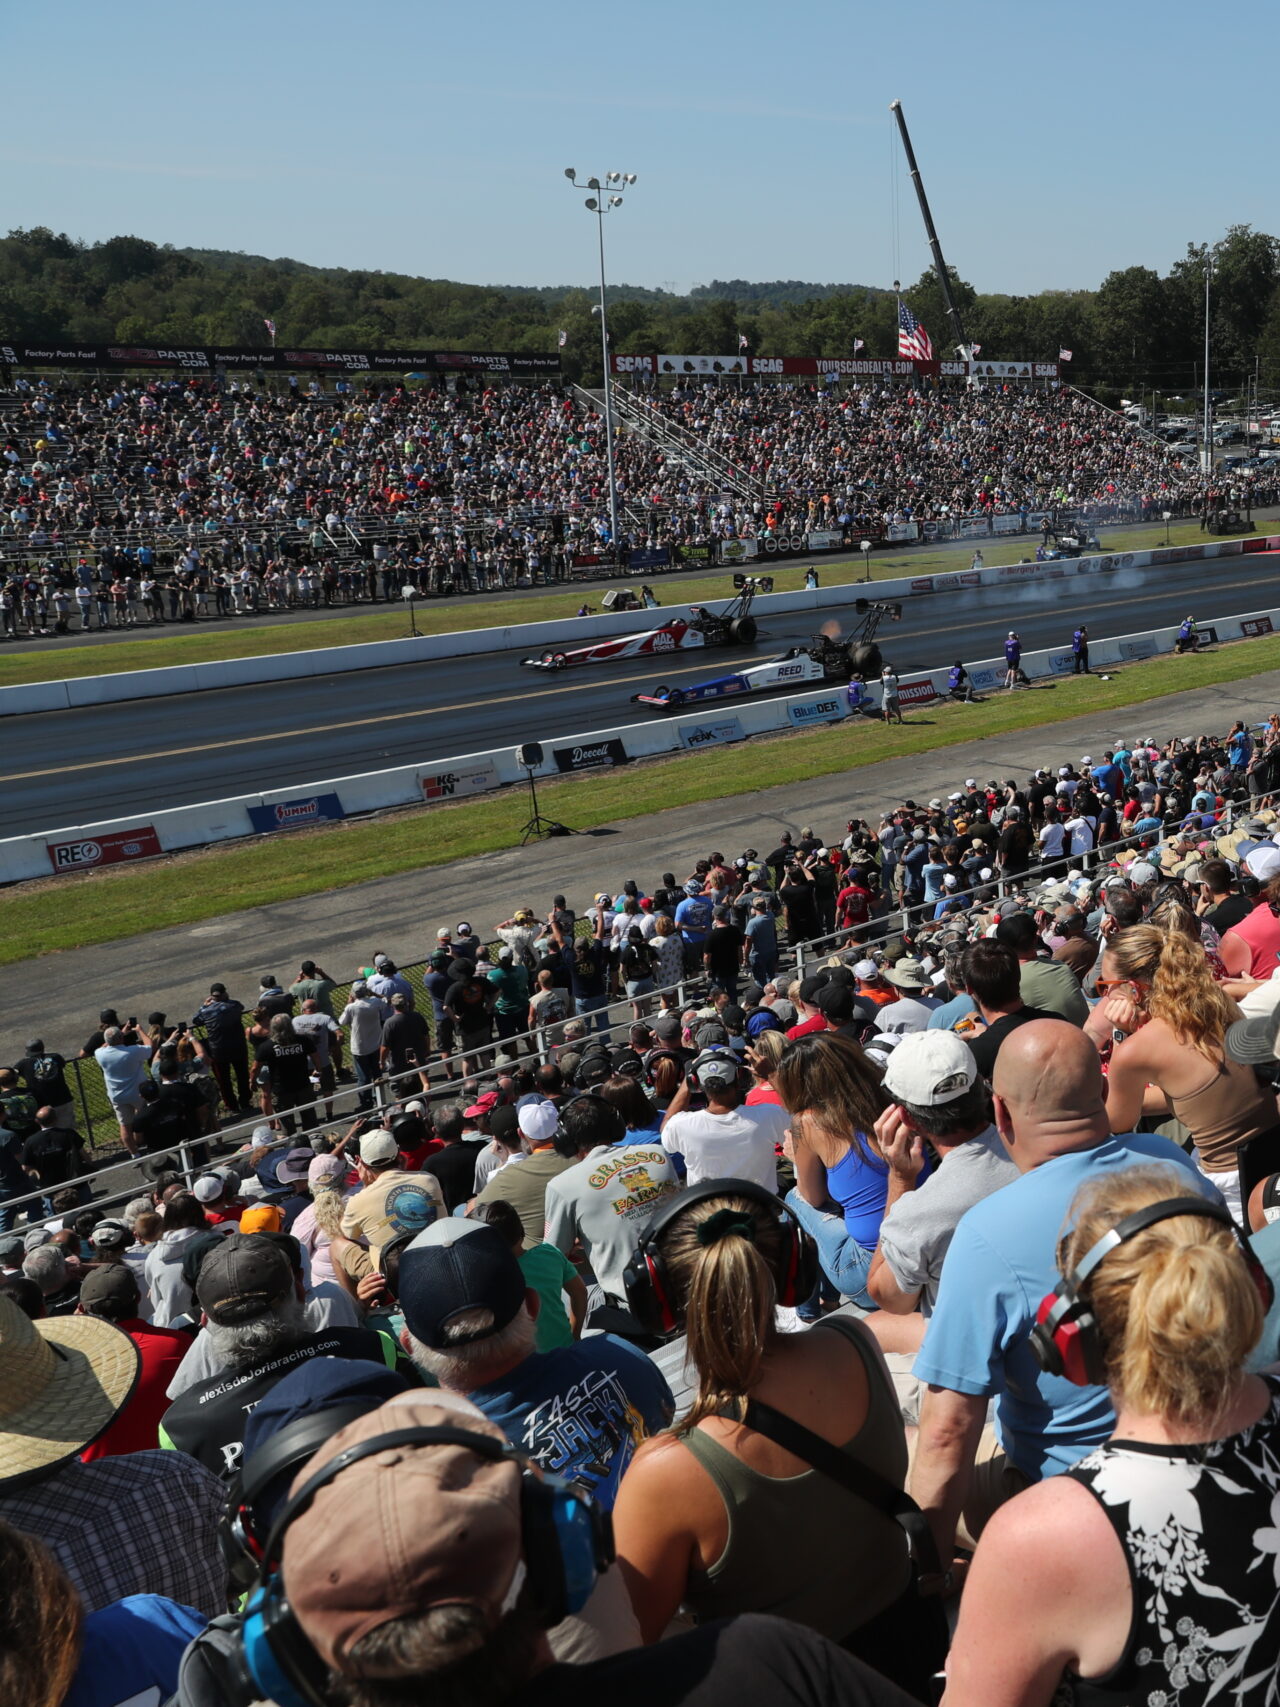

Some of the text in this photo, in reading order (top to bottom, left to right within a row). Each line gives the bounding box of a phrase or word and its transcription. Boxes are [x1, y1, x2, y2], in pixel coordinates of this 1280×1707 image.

[25, 350, 54, 358] Factory
[56, 350, 76, 358] Parts
[616, 356, 651, 372] SCAG
[752, 358, 784, 373] SCAG
[816, 359, 914, 374] YOURSCAGDEALER.COM
[940, 362, 965, 375] SCAG
[1035, 364, 1057, 376] SCAG
[653, 633, 675, 645] MAC
[778, 665, 802, 677] REED
[793, 701, 839, 718] BlueDEF
[687, 729, 717, 747] PEAK
[571, 744, 609, 763] Deecell
[273, 1044, 304, 1057] Diesel
[589, 1151, 666, 1190] GRASSO
[386, 1187, 402, 1210] NORTH
[199, 1339, 341, 1404] alexisdeJoriaracing.com
[522, 1369, 617, 1449] FAST
[548, 1387, 625, 1470] JACK
